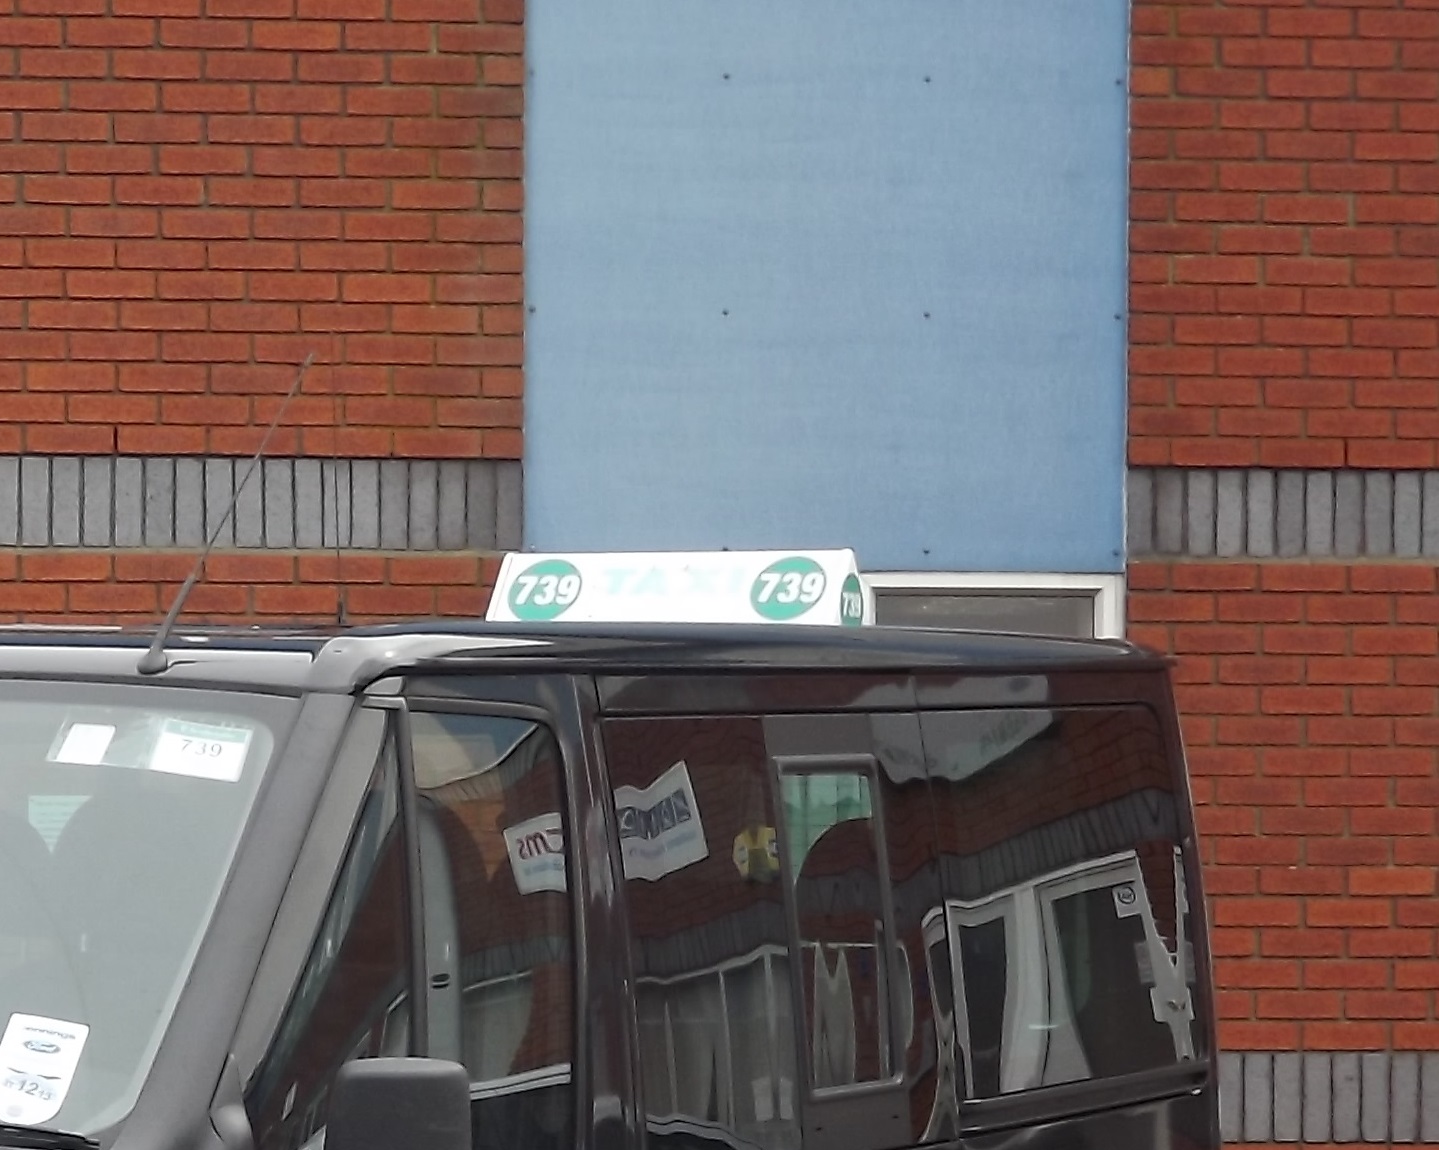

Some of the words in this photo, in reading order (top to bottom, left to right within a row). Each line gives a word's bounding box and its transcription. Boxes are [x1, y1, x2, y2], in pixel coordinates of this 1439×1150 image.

[517, 574, 582, 606] 739
[603, 568, 746, 595] TAXI
[757, 572, 826, 603] 739
[181, 738, 223, 758] 739
